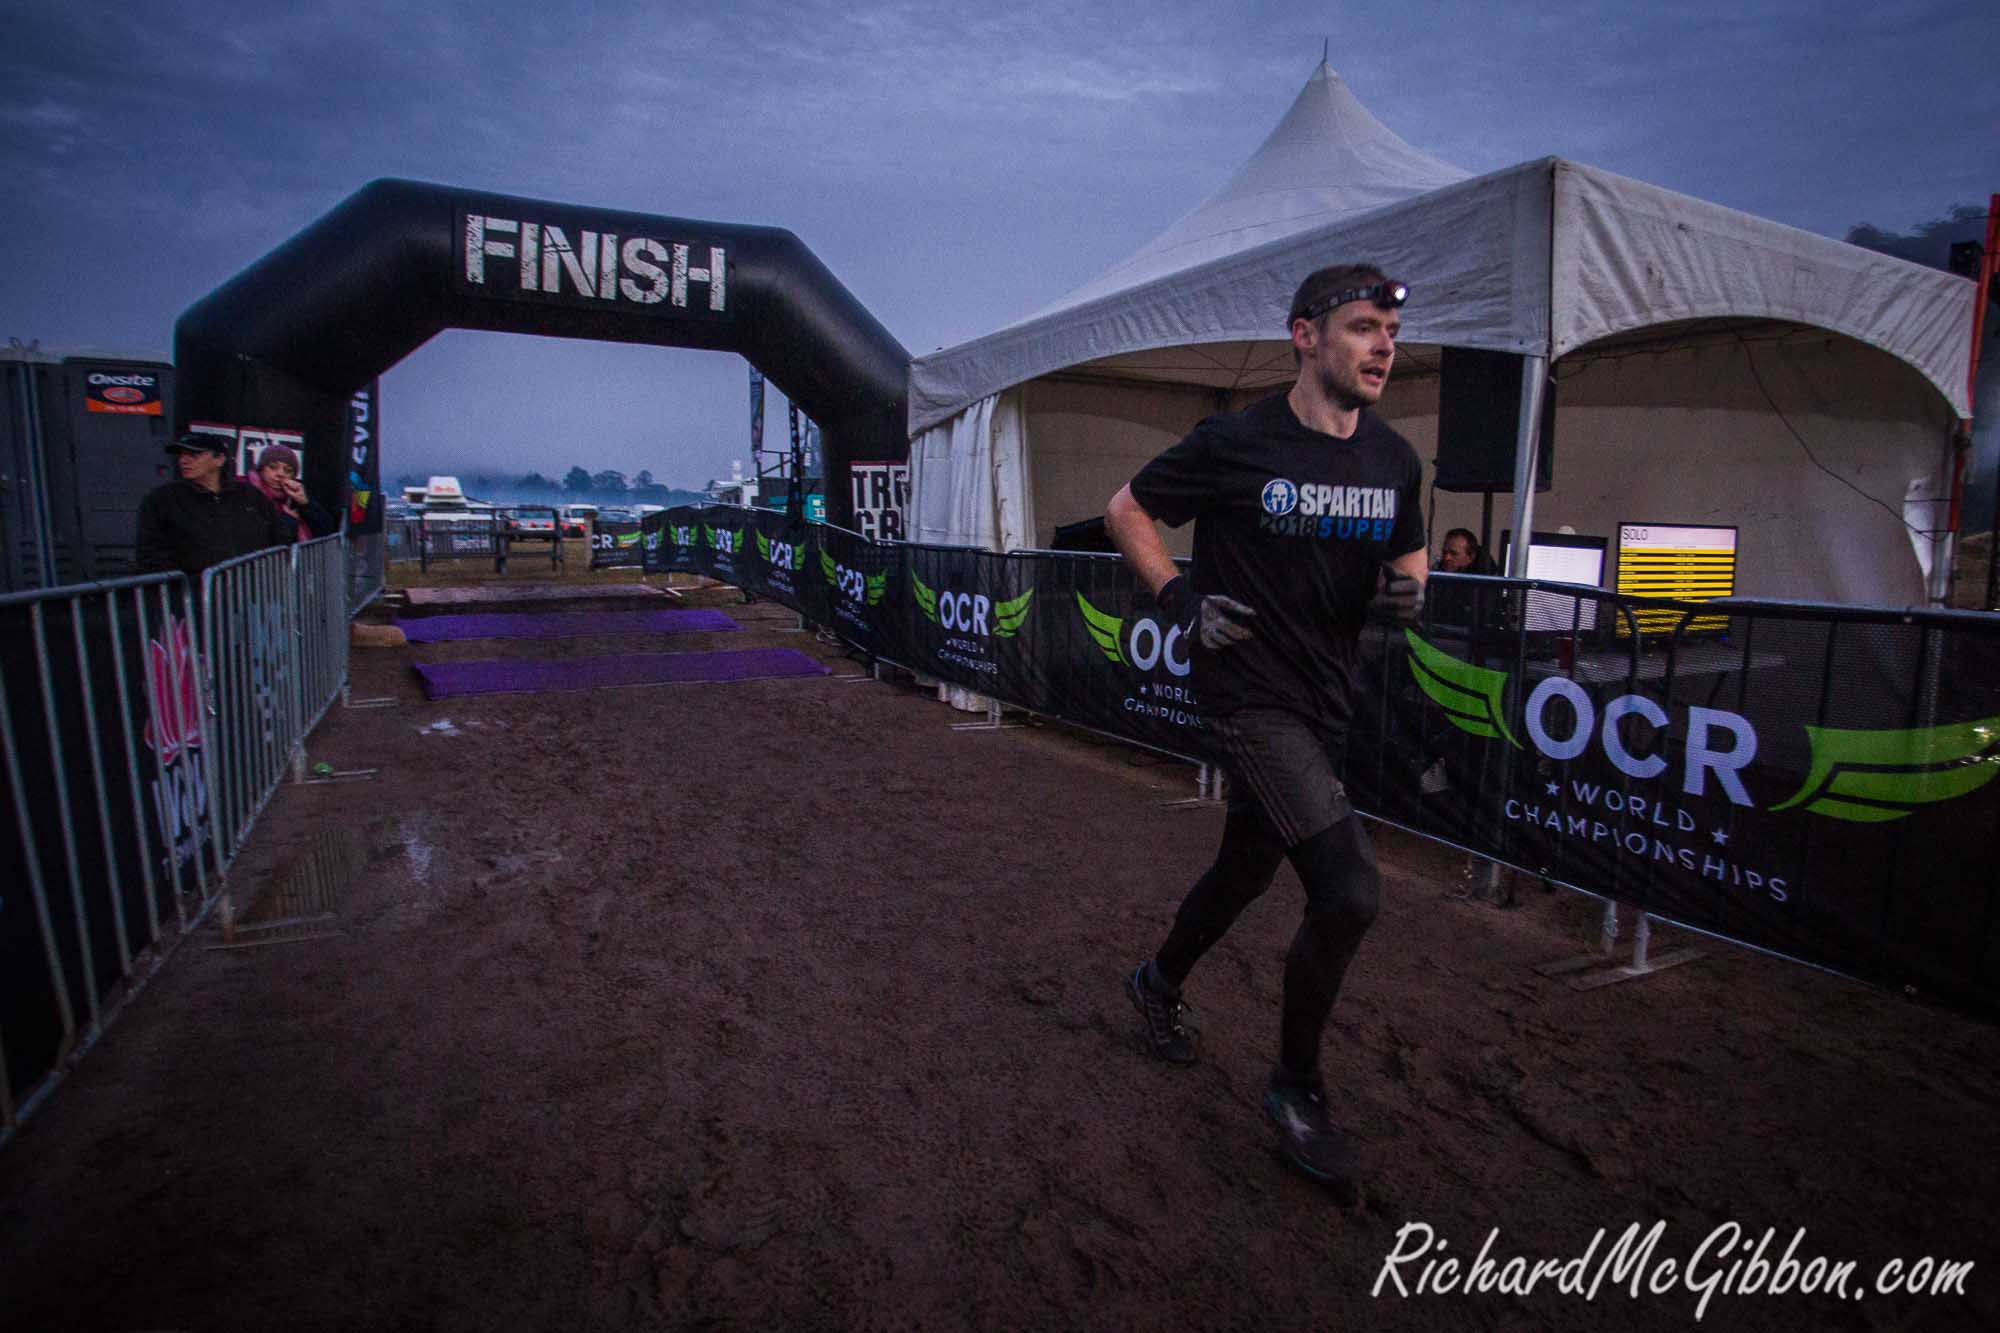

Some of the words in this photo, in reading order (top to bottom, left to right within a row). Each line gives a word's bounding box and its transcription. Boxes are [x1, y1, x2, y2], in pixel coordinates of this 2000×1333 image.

[465, 214, 726, 311] FINISH
[1300, 483, 1396, 519] SPARTAN
[1623, 528, 1648, 540] SOLO
[939, 590, 990, 636] OCR
[1129, 617, 1191, 677] OC
[1152, 682, 1197, 705] WORL
[1525, 676, 1758, 807] OCR
[1572, 780, 1697, 832] WORLD
[1504, 799, 1789, 903] CHAMPIONSHIPS
